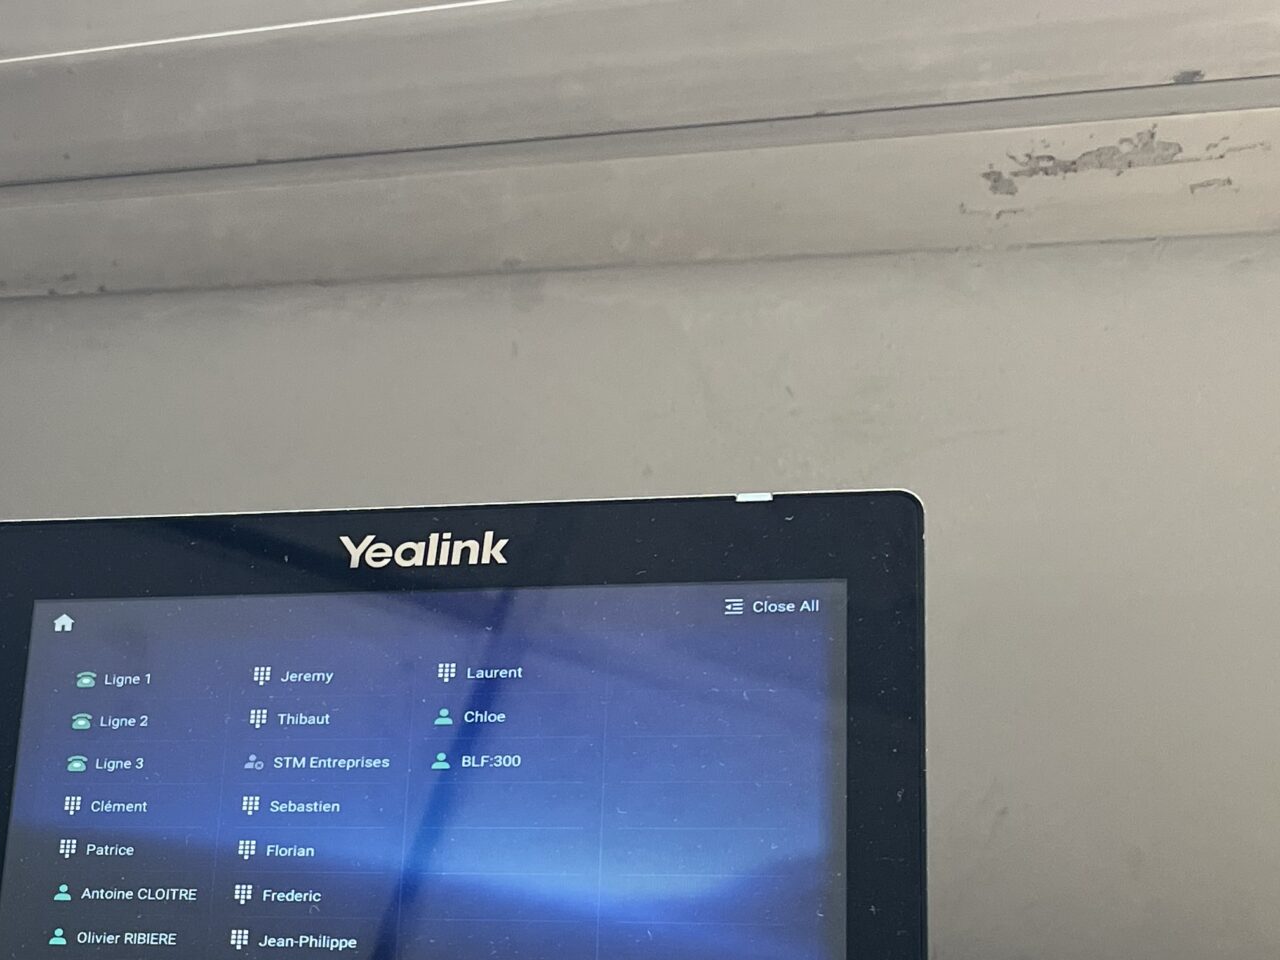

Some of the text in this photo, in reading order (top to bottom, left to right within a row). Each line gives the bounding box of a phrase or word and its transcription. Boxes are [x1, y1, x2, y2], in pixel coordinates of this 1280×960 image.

[339, 531, 509, 568] Yealink
[752, 599, 819, 613] Close All
[281, 671, 334, 684] Jeremy
[467, 667, 523, 679] Laurent
[104, 673, 151, 687] Ligne 1
[100, 715, 149, 729] Ligne 2
[277, 713, 330, 725] Thibaut
[464, 710, 506, 723] Chloe
[95, 757, 144, 772] Ligne 3
[273, 756, 390, 770] STM Entreprises
[461, 755, 521, 767] BLF:300
[91, 800, 148, 813] Clément
[269, 800, 340, 813] Sebastien
[86, 844, 134, 856] Patrice
[266, 845, 315, 857] Florian
[80, 887, 197, 900] Antoine CLOITRE
[262, 889, 322, 902] Frederic
[77, 931, 177, 945] Olivier RIBIERE
[258, 934, 357, 951] Jean-Philippe
